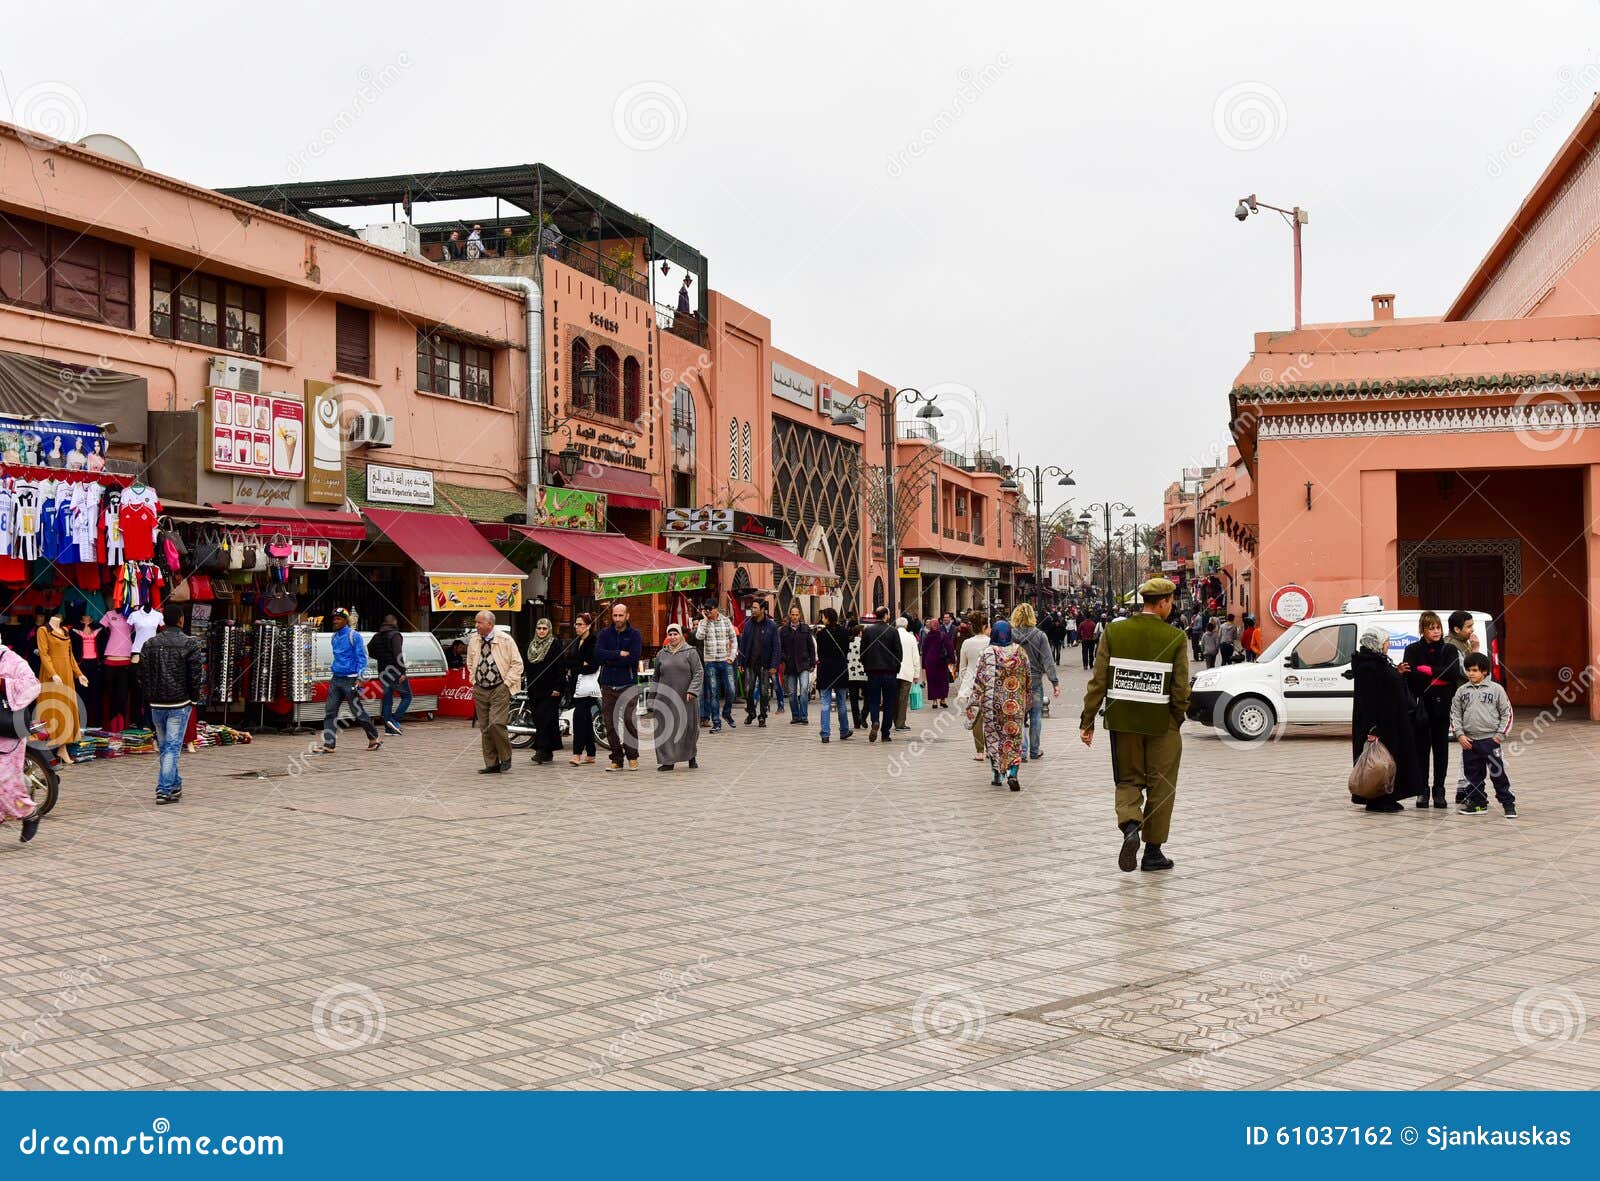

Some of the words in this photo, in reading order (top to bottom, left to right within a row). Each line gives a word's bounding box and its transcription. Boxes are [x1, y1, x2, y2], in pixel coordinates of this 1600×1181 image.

[257, 480, 293, 506] Legend
[1114, 679, 1133, 690] FORCES
[1133, 681, 1161, 693] AUXILIAIRES
